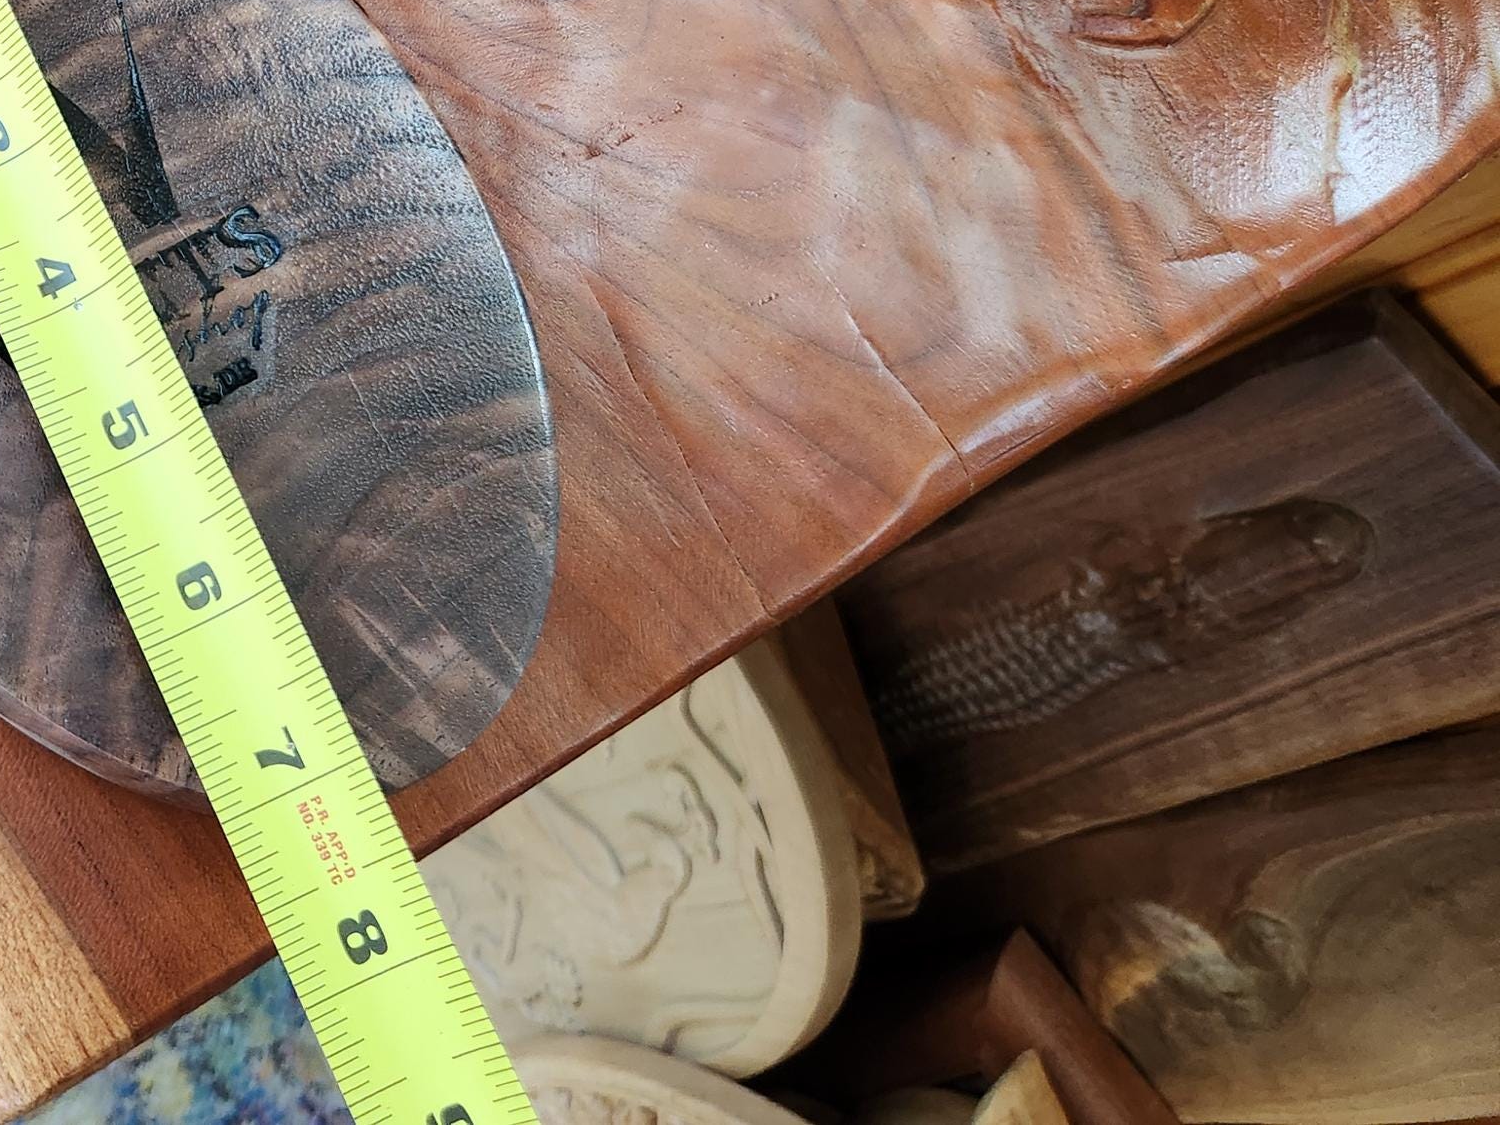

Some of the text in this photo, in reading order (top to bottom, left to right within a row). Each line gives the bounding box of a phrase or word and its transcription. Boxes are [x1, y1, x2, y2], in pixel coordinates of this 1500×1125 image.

[35, 256, 79, 300] 4
[101, 399, 151, 451] 5
[176, 561, 223, 611] 6
[253, 725, 306, 772] 7
[310, 795, 329, 825] P.R.
[296, 801, 343, 885] NO. 339 TC
[337, 909, 388, 965] 8
